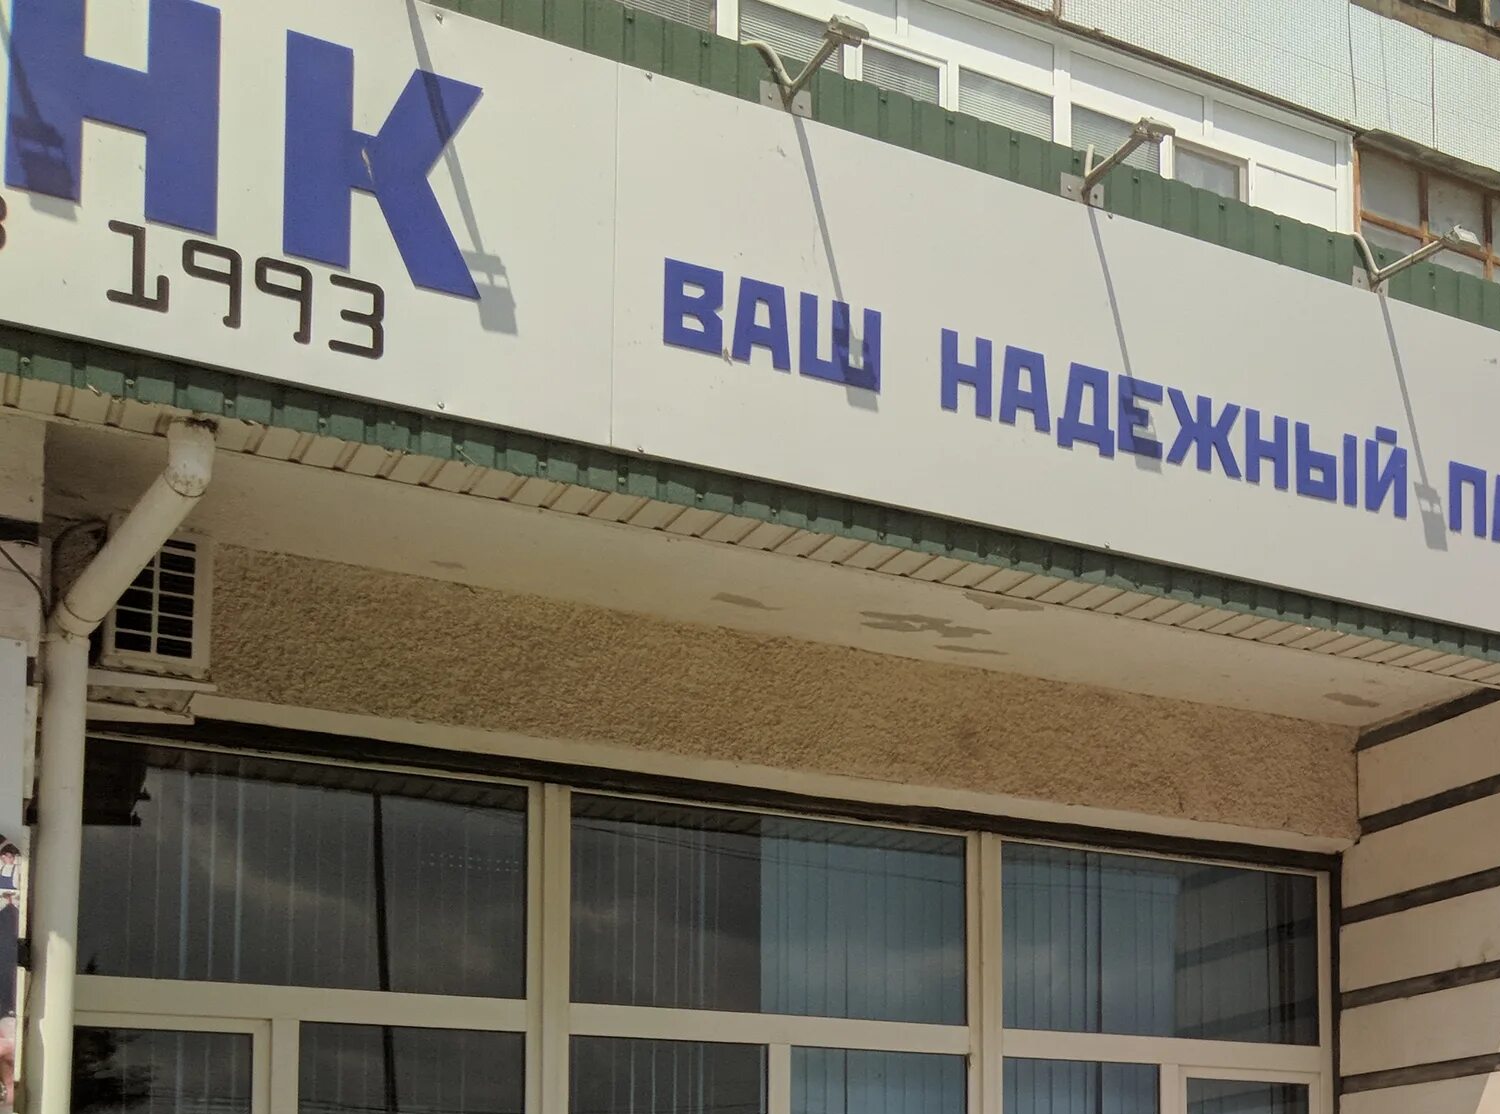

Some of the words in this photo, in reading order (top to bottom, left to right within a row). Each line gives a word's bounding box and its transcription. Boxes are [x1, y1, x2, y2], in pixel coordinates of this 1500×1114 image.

[106, 219, 386, 360] 1993
[663, 257, 881, 393] ВАШ
[941, 328, 1407, 519] НАДЕЖНЫЙ
